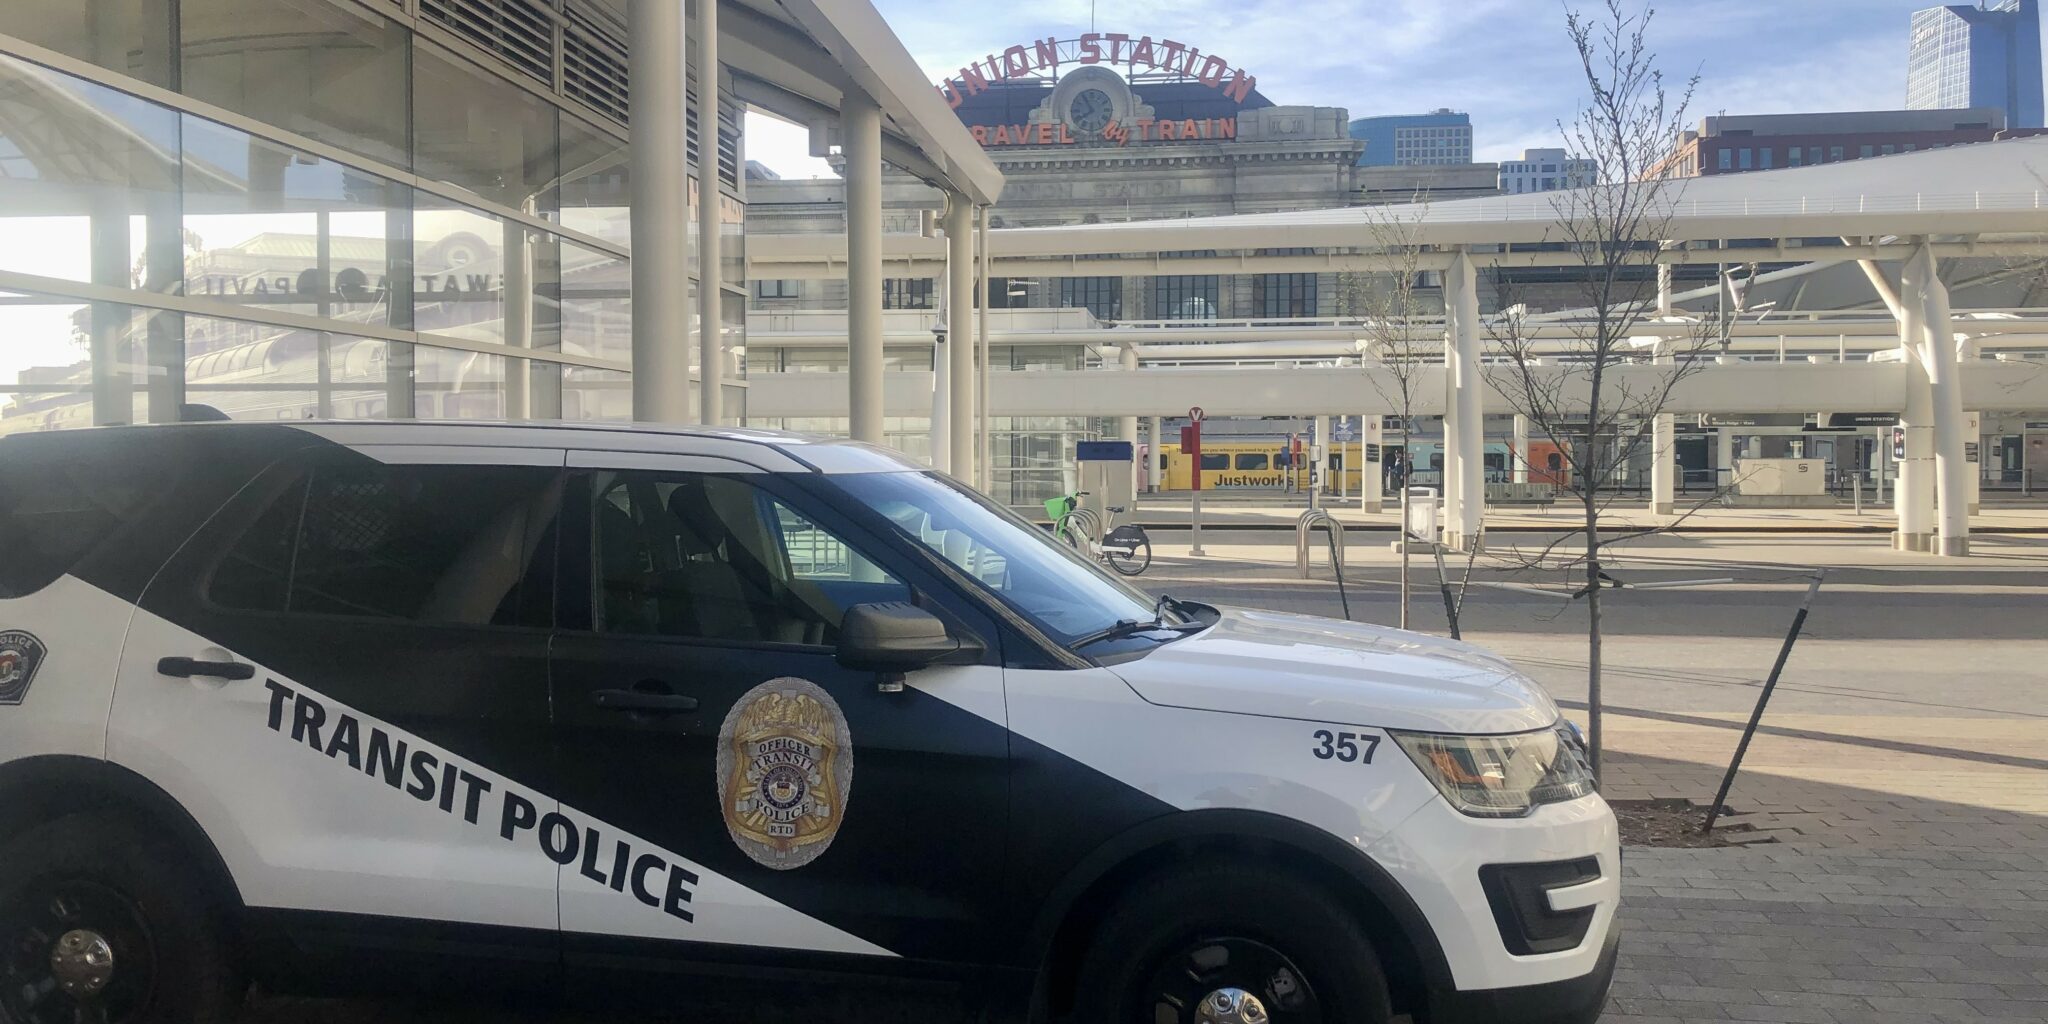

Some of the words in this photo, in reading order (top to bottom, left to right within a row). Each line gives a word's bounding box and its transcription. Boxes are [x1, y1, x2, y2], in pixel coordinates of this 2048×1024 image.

[934, 37, 1060, 110] UNION
[1080, 33, 1256, 104] STATION
[971, 123, 1074, 145] RAVEL
[1103, 120, 1130, 146] by
[1138, 118, 1235, 140] TRAIN
[1214, 474, 1294, 487] Justworks
[0, 635, 33, 648] OLICE
[759, 738, 811, 756] OFFICER
[1312, 729, 1381, 765] 357
[753, 751, 818, 772] TRANSIT
[265, 678, 491, 825] TRANSIT
[500, 791, 699, 923] POLICE
[756, 799, 810, 822] POLICE
[770, 825, 793, 834] RTD
